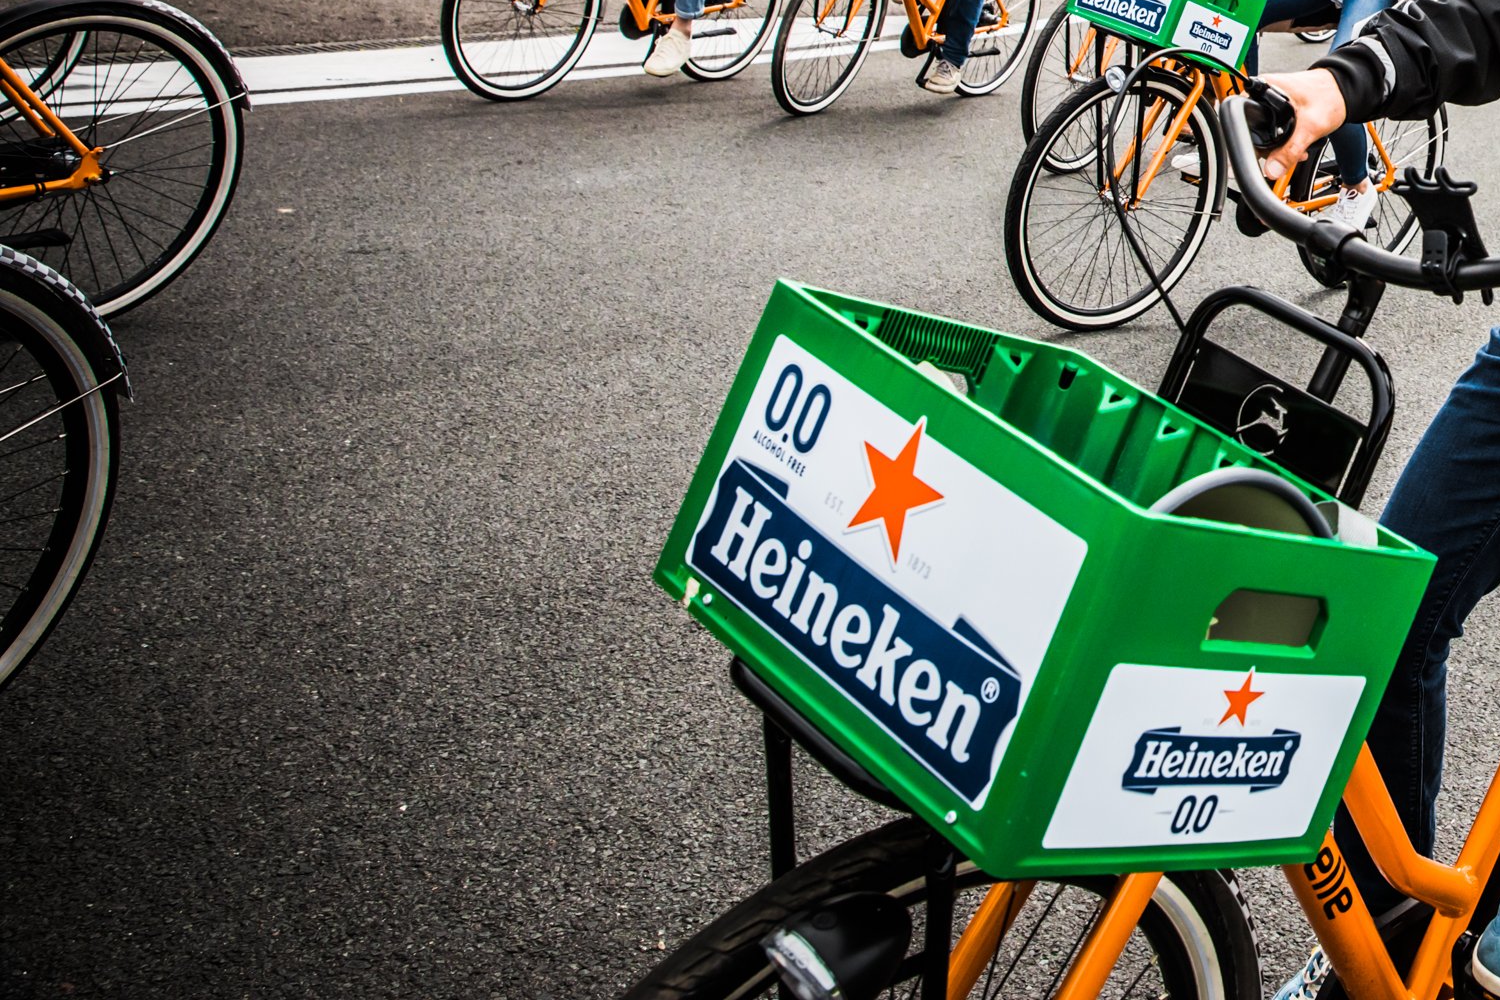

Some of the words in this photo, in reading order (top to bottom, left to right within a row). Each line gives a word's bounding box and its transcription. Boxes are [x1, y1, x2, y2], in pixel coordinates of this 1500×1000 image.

[764, 362, 833, 454] 0.0
[752, 429, 786, 462] ALCOHOL
[786, 455, 806, 477] FREE
[907, 552, 932, 580] 1873
[1170, 794, 1219, 835] 0.0
